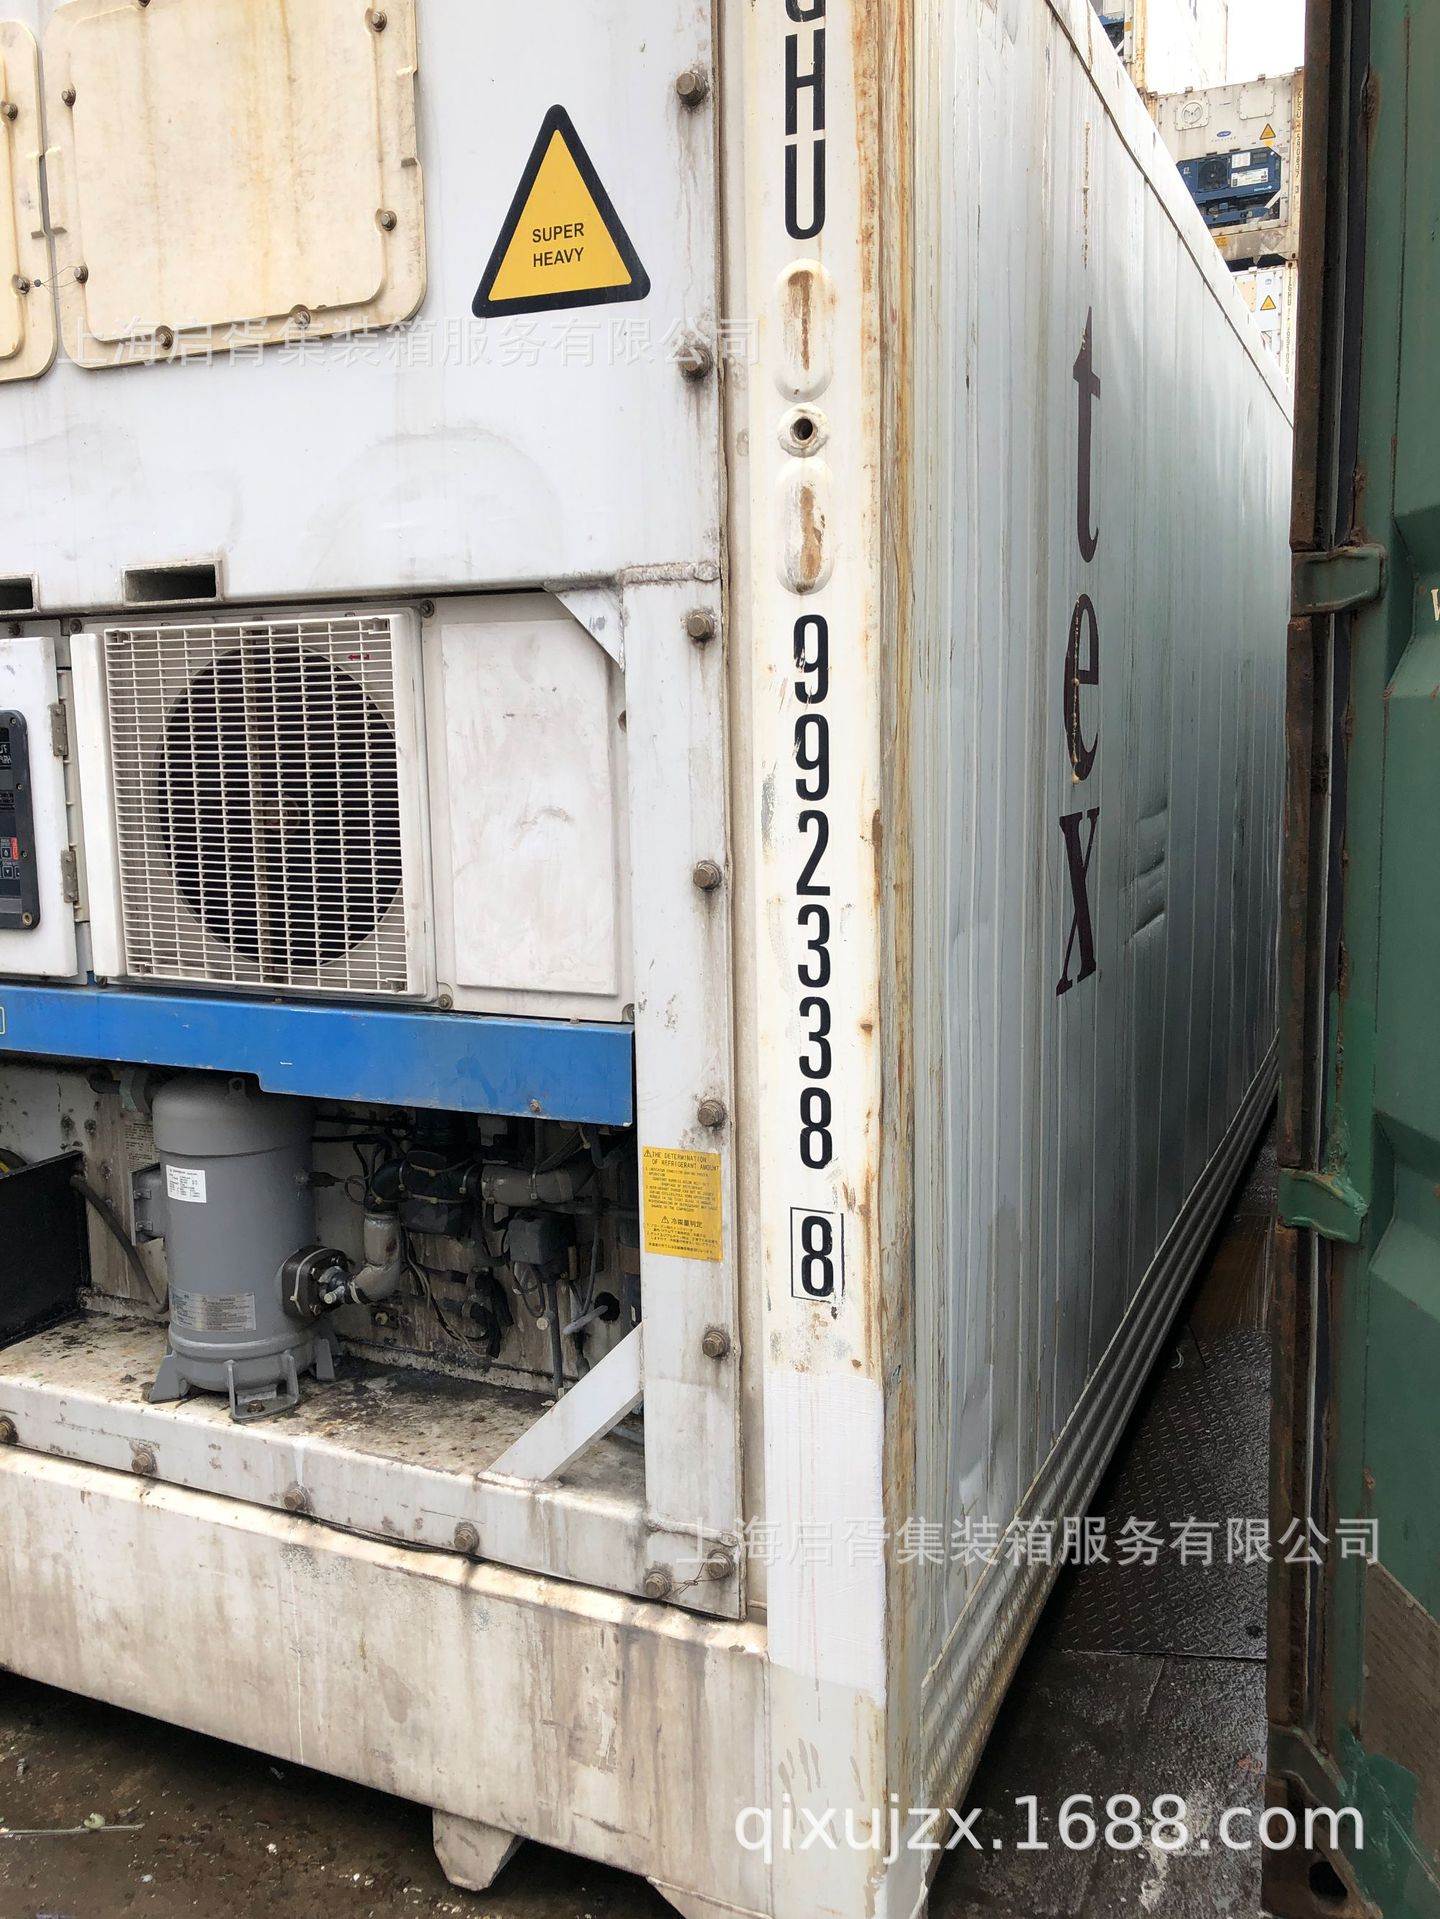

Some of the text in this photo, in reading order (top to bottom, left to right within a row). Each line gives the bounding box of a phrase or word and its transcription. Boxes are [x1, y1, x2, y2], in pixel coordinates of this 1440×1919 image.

[784, 0, 826, 240] HU
[532, 222, 585, 243] SUPER
[533, 247, 585, 268] HEAVY
[793, 614, 834, 1170] 992338
[652, 1151, 707, 1163] THE DETERMINATION
[662, 1160, 697, 1169] REFRIGERANT
[801, 1216, 834, 1297] 8
